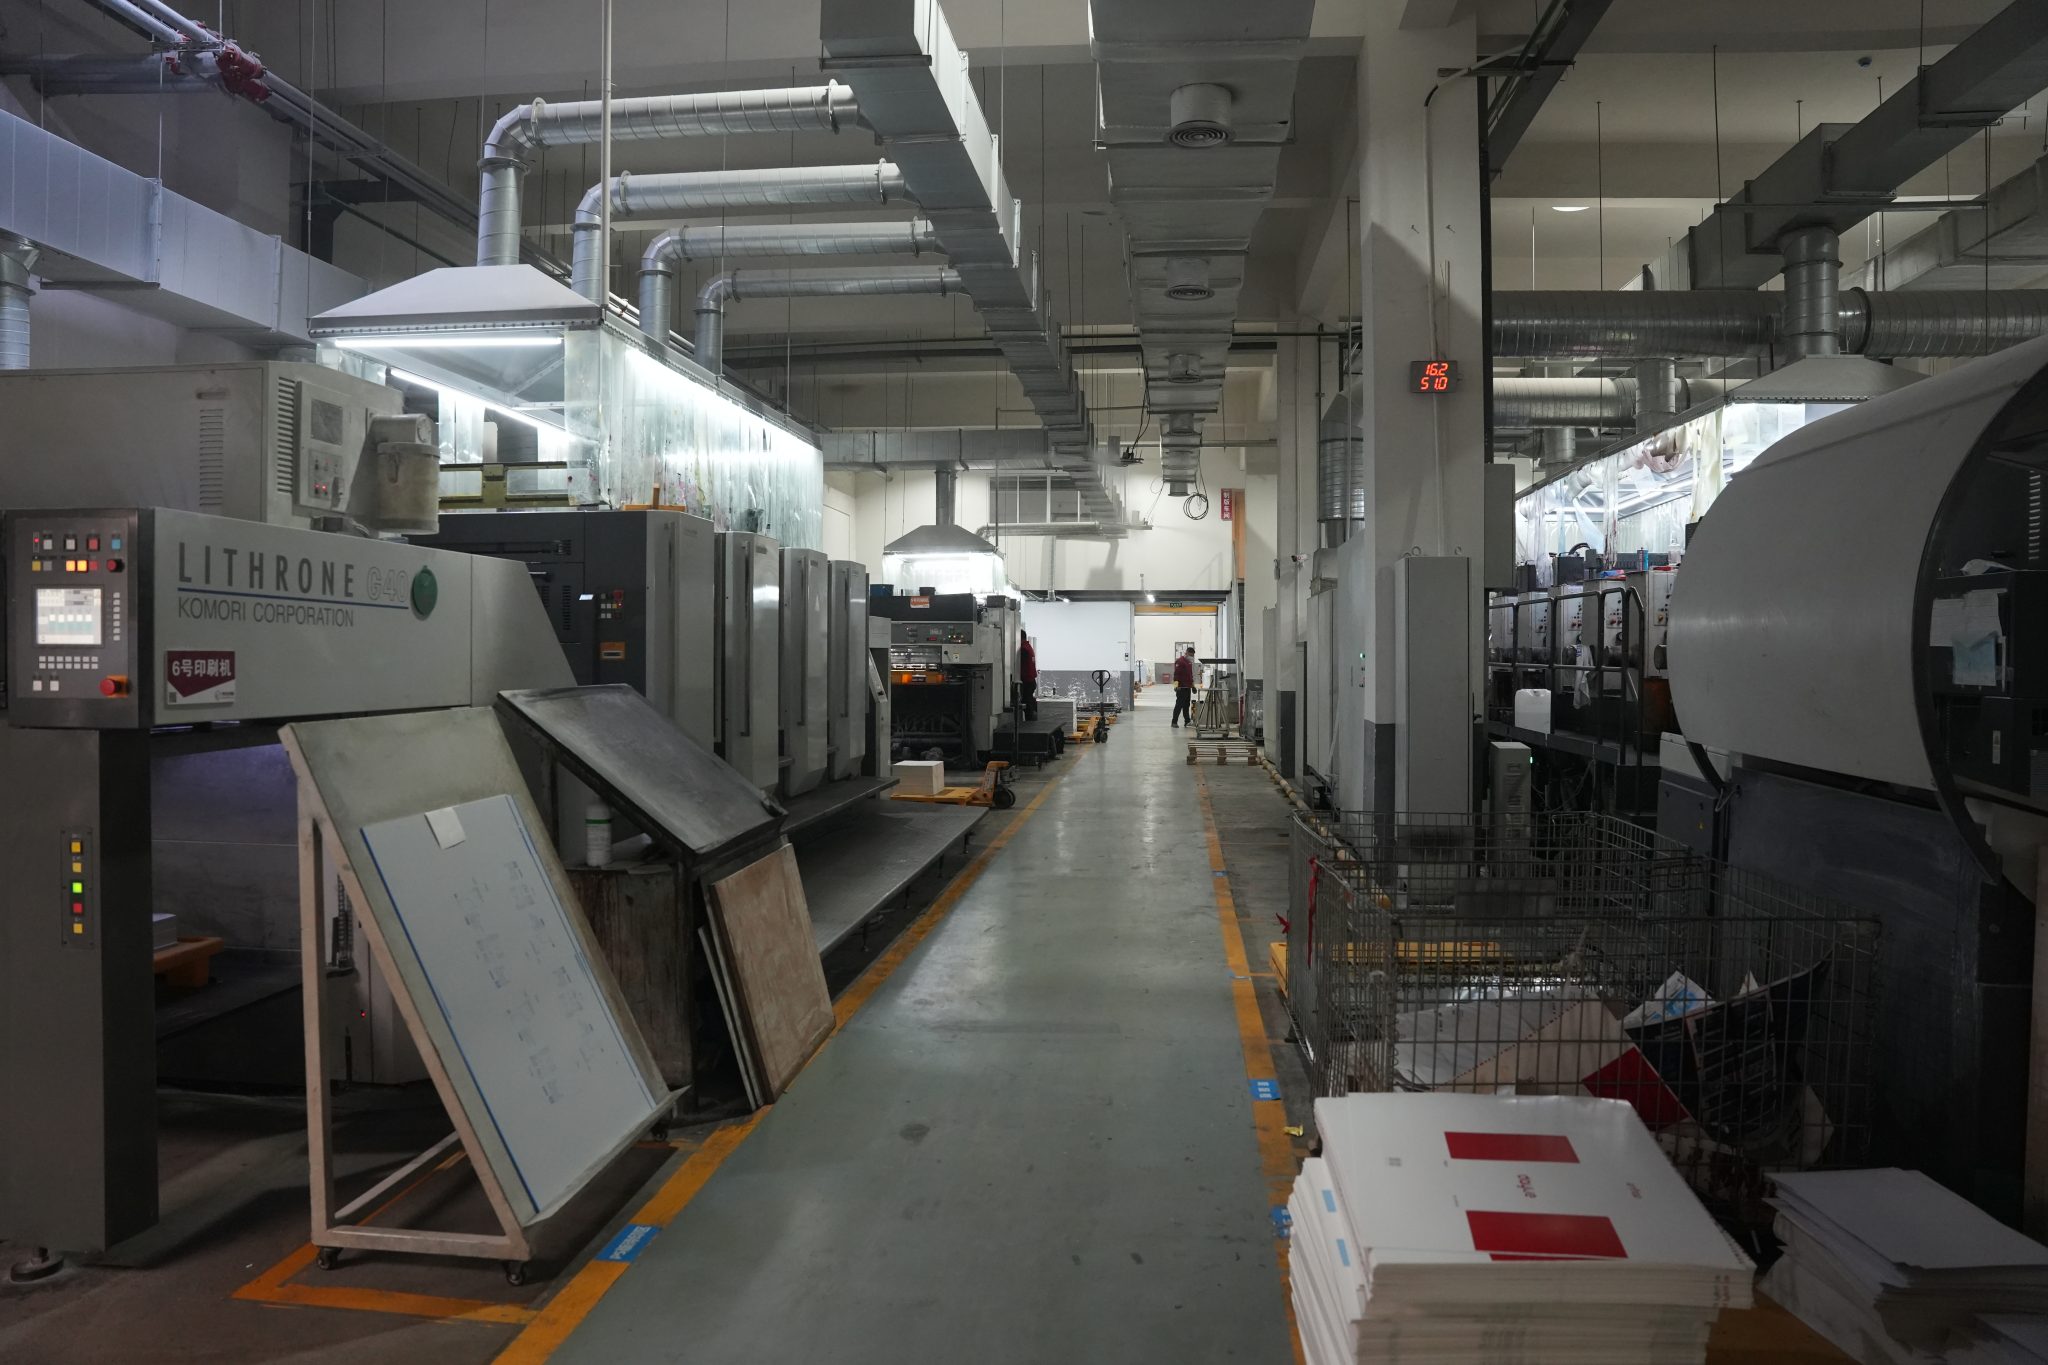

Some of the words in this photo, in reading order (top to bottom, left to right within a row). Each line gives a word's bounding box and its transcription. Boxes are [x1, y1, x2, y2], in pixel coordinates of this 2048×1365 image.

[1425, 363, 1448, 376] 16.2
[179, 542, 354, 598] LITHRONE
[367, 566, 409, 603] G40
[178, 596, 247, 623] KOMORI
[252, 602, 354, 628] CORPORATION
[171, 658, 232, 678] 6号印刷机
